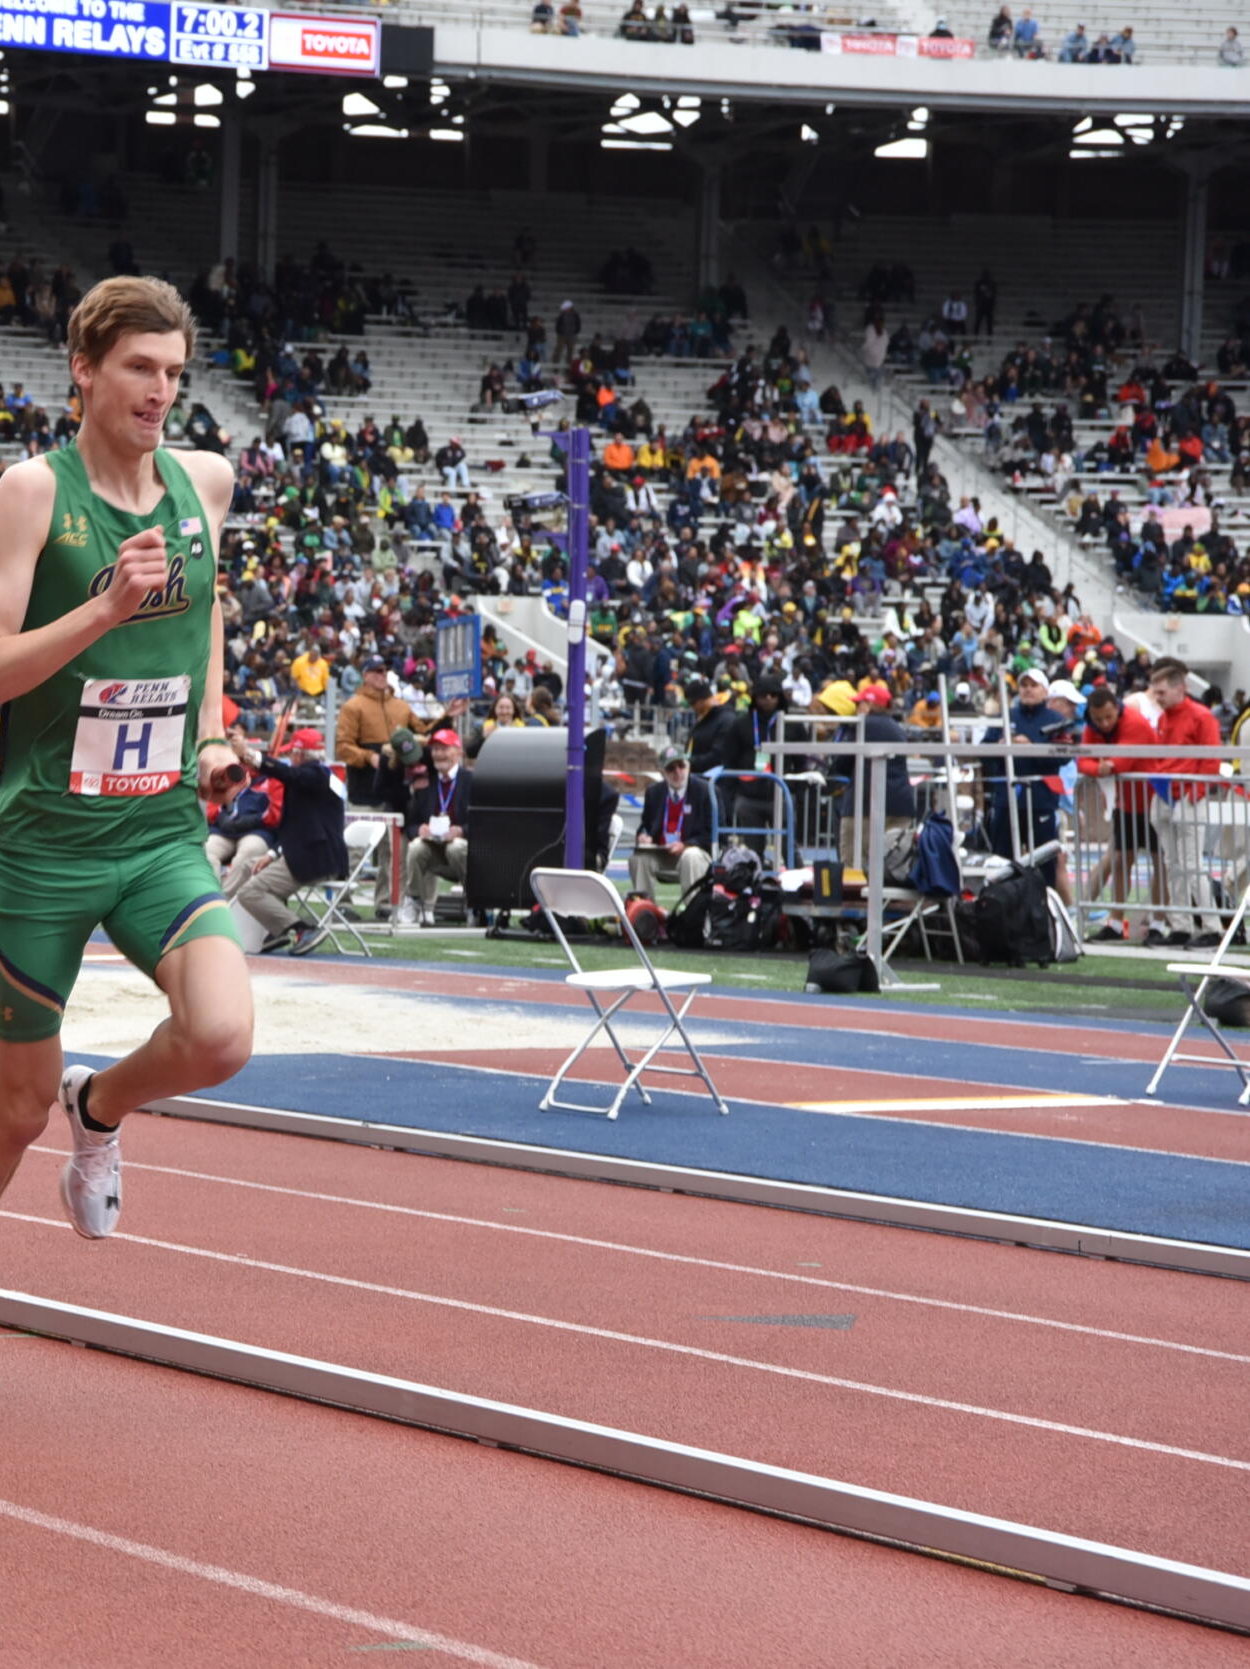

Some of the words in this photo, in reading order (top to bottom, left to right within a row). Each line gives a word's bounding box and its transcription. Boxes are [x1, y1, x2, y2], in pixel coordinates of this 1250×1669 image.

[80, 0, 106, 18] TO
[109, 1, 145, 21] THE
[182, 8, 259, 38] 7:00.2
[53, 18, 166, 56] RELAYS
[303, 33, 370, 55] TOYOTA
[112, 722, 153, 770] H
[106, 774, 170, 793] TOYOTA
